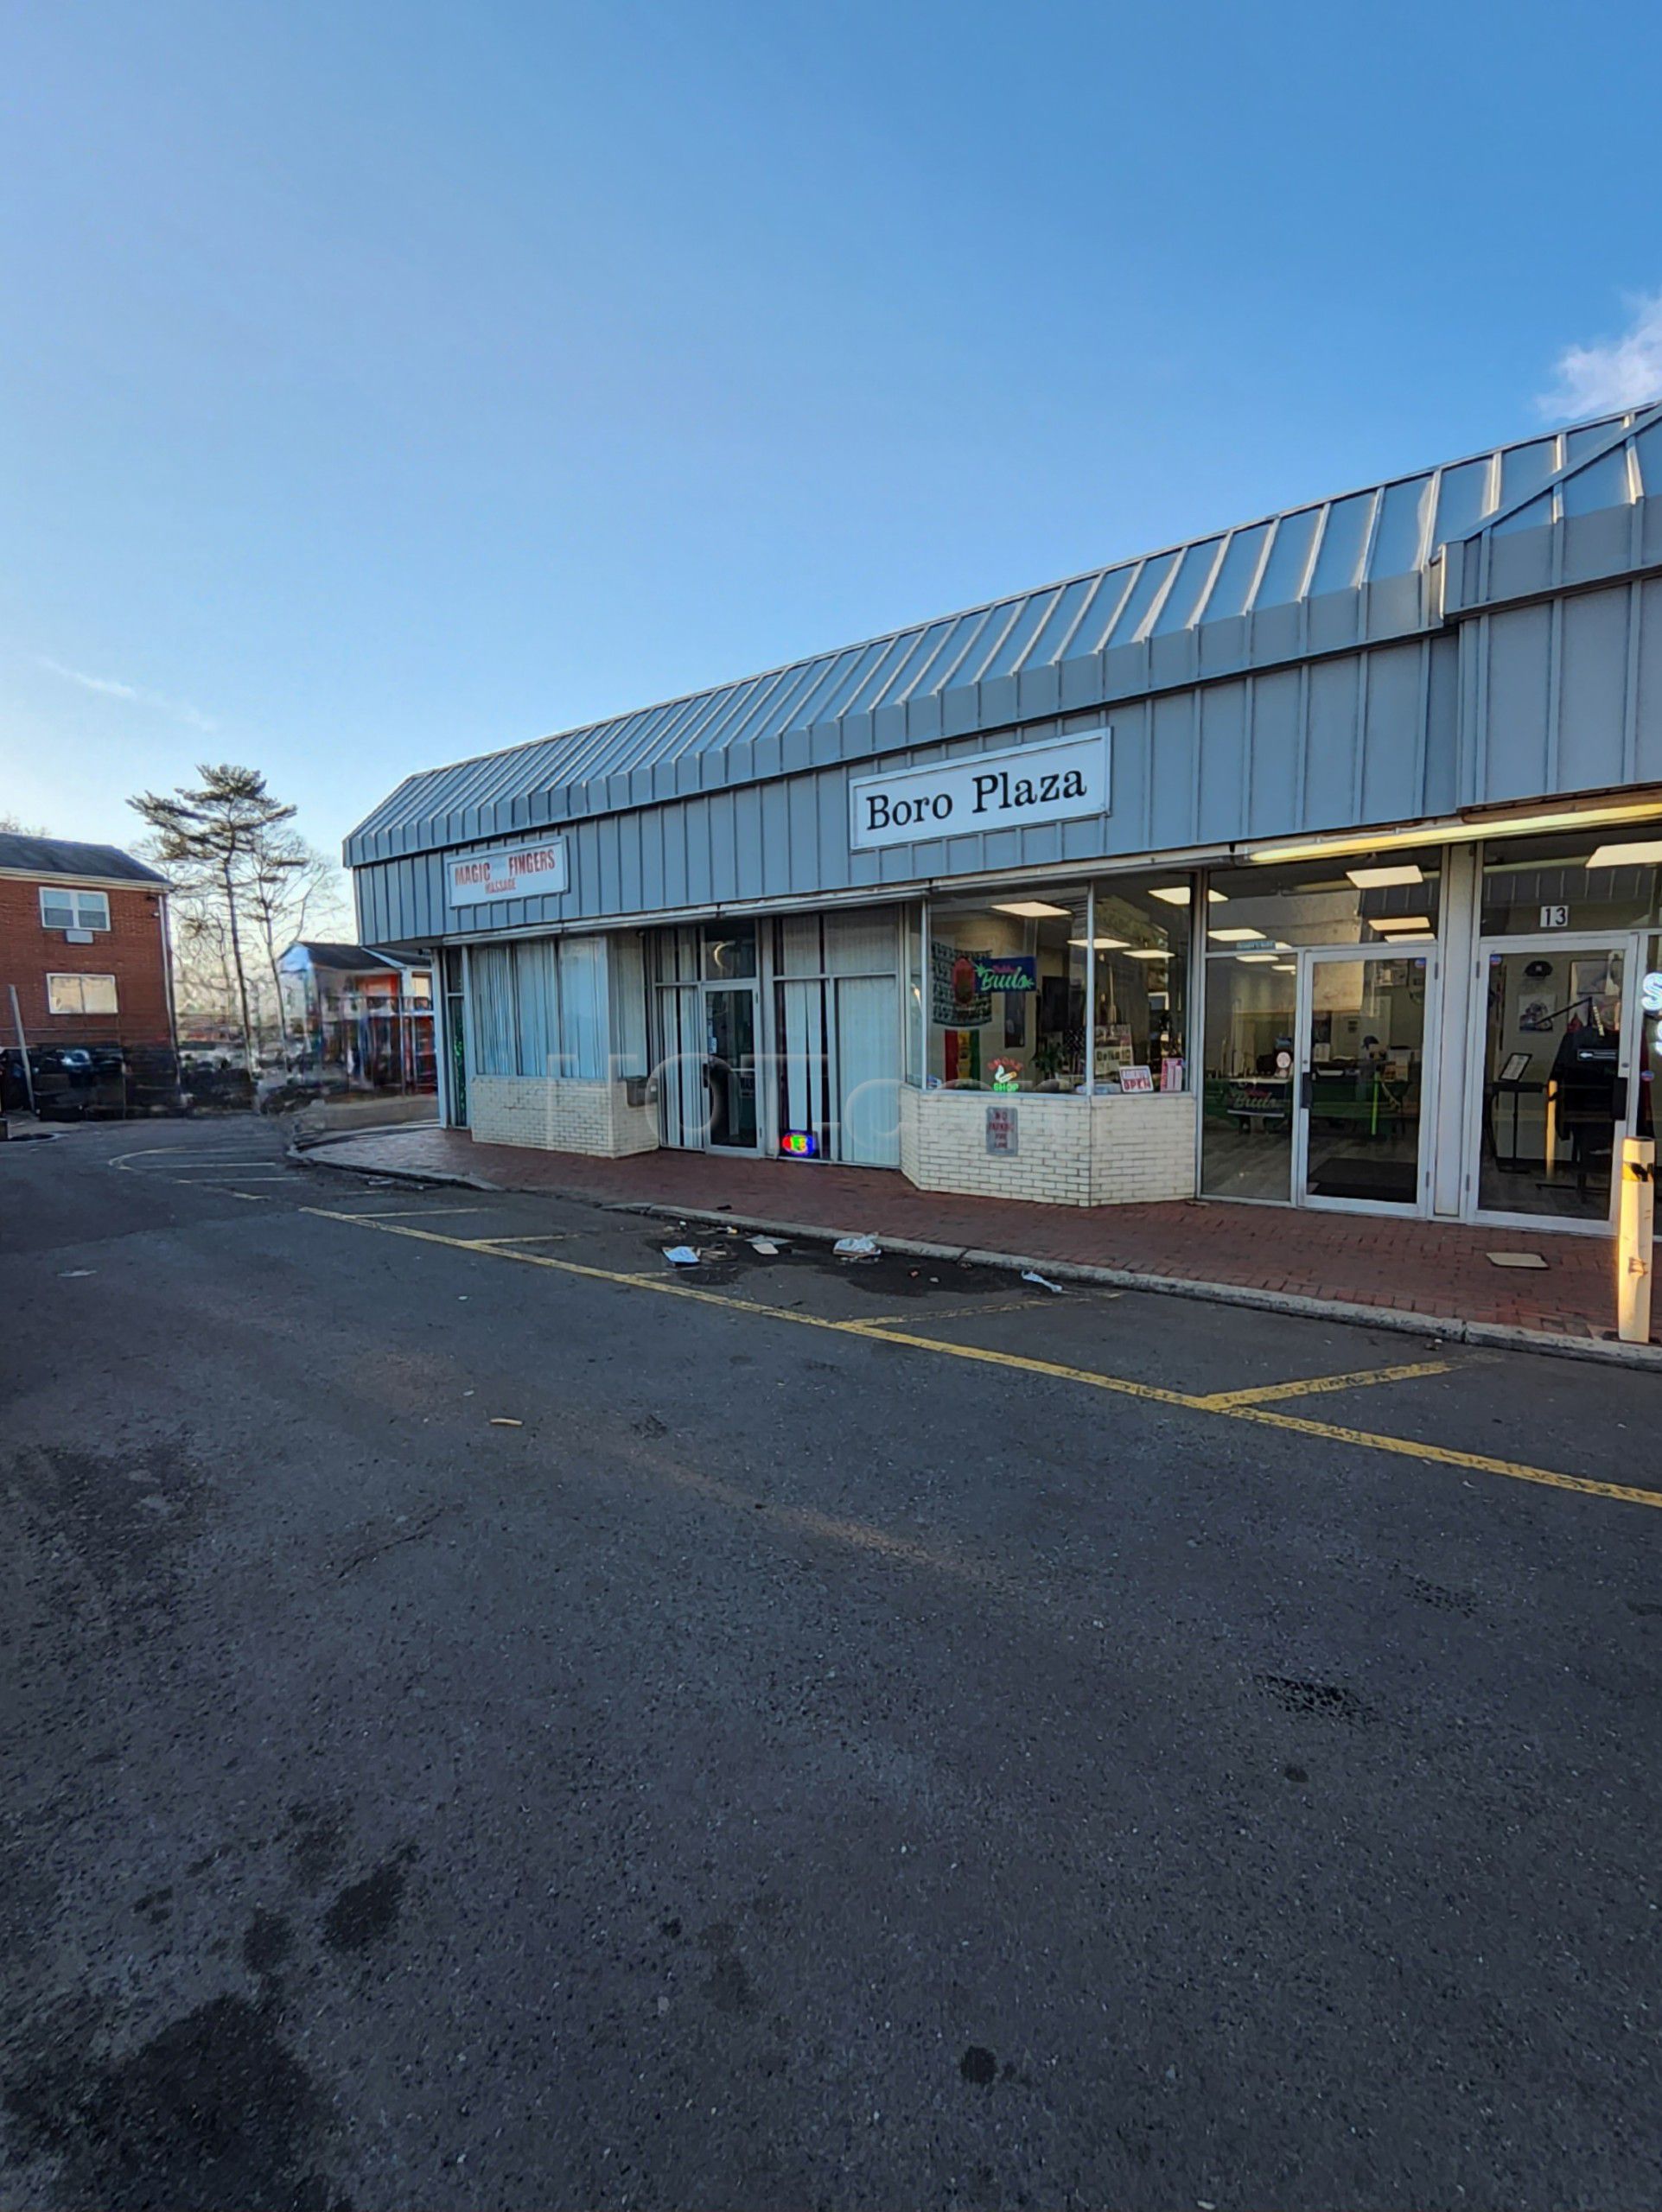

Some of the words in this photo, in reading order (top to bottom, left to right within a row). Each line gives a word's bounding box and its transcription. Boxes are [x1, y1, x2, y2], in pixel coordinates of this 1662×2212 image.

[866, 793, 952, 830] Boro
[972, 770, 1086, 813] Plaza
[455, 862, 490, 887] MAGIC
[508, 849, 556, 877] FINGERS
[1544, 906, 1566, 927] 13
[993, 1082, 1019, 1093] SHOP
